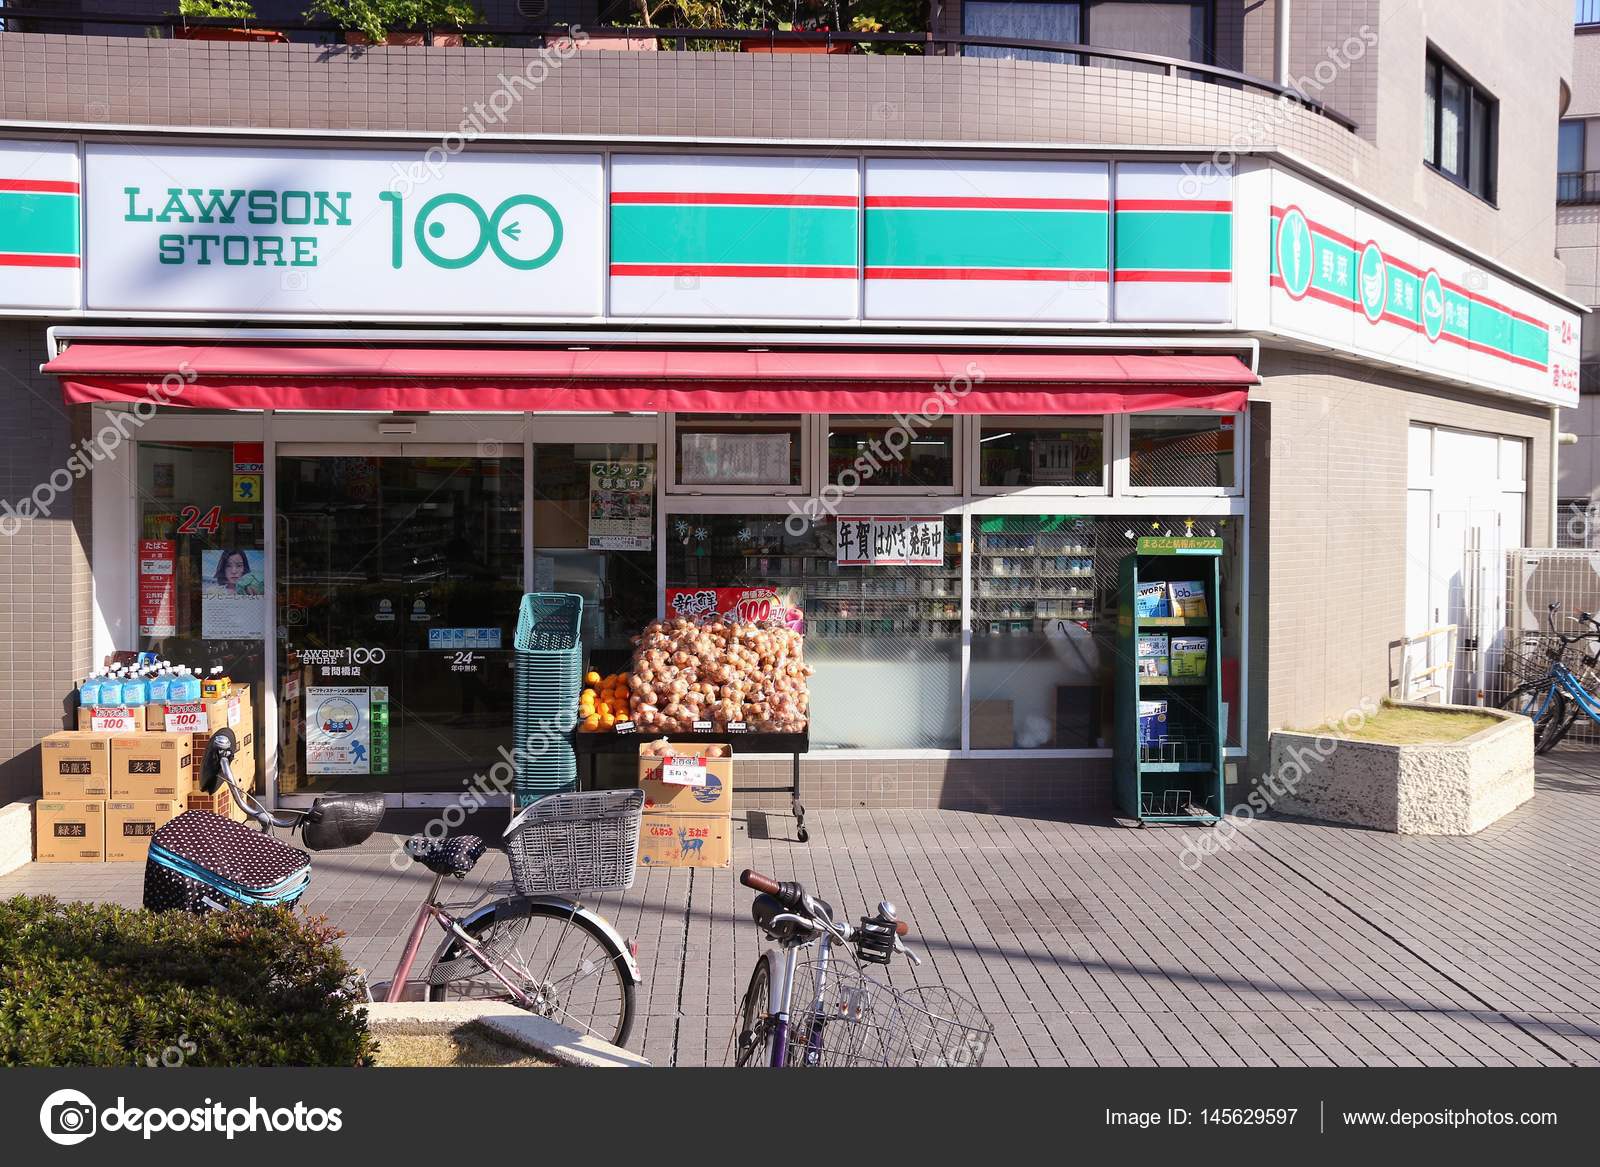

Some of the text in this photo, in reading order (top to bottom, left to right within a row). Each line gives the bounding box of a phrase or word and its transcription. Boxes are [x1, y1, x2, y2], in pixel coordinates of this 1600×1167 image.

[124, 187, 563, 270] LAWSON 100
[158, 234, 318, 268] STORE
[177, 505, 222, 534] 24
[838, 520, 942, 560] 年賀はがき発売中
[672, 590, 718, 616] 新鮮
[296, 647, 385, 664] LAWSON 100
[453, 651, 473, 664] 24
[103, 719, 124, 729] 100
[176, 714, 197, 725] 100
